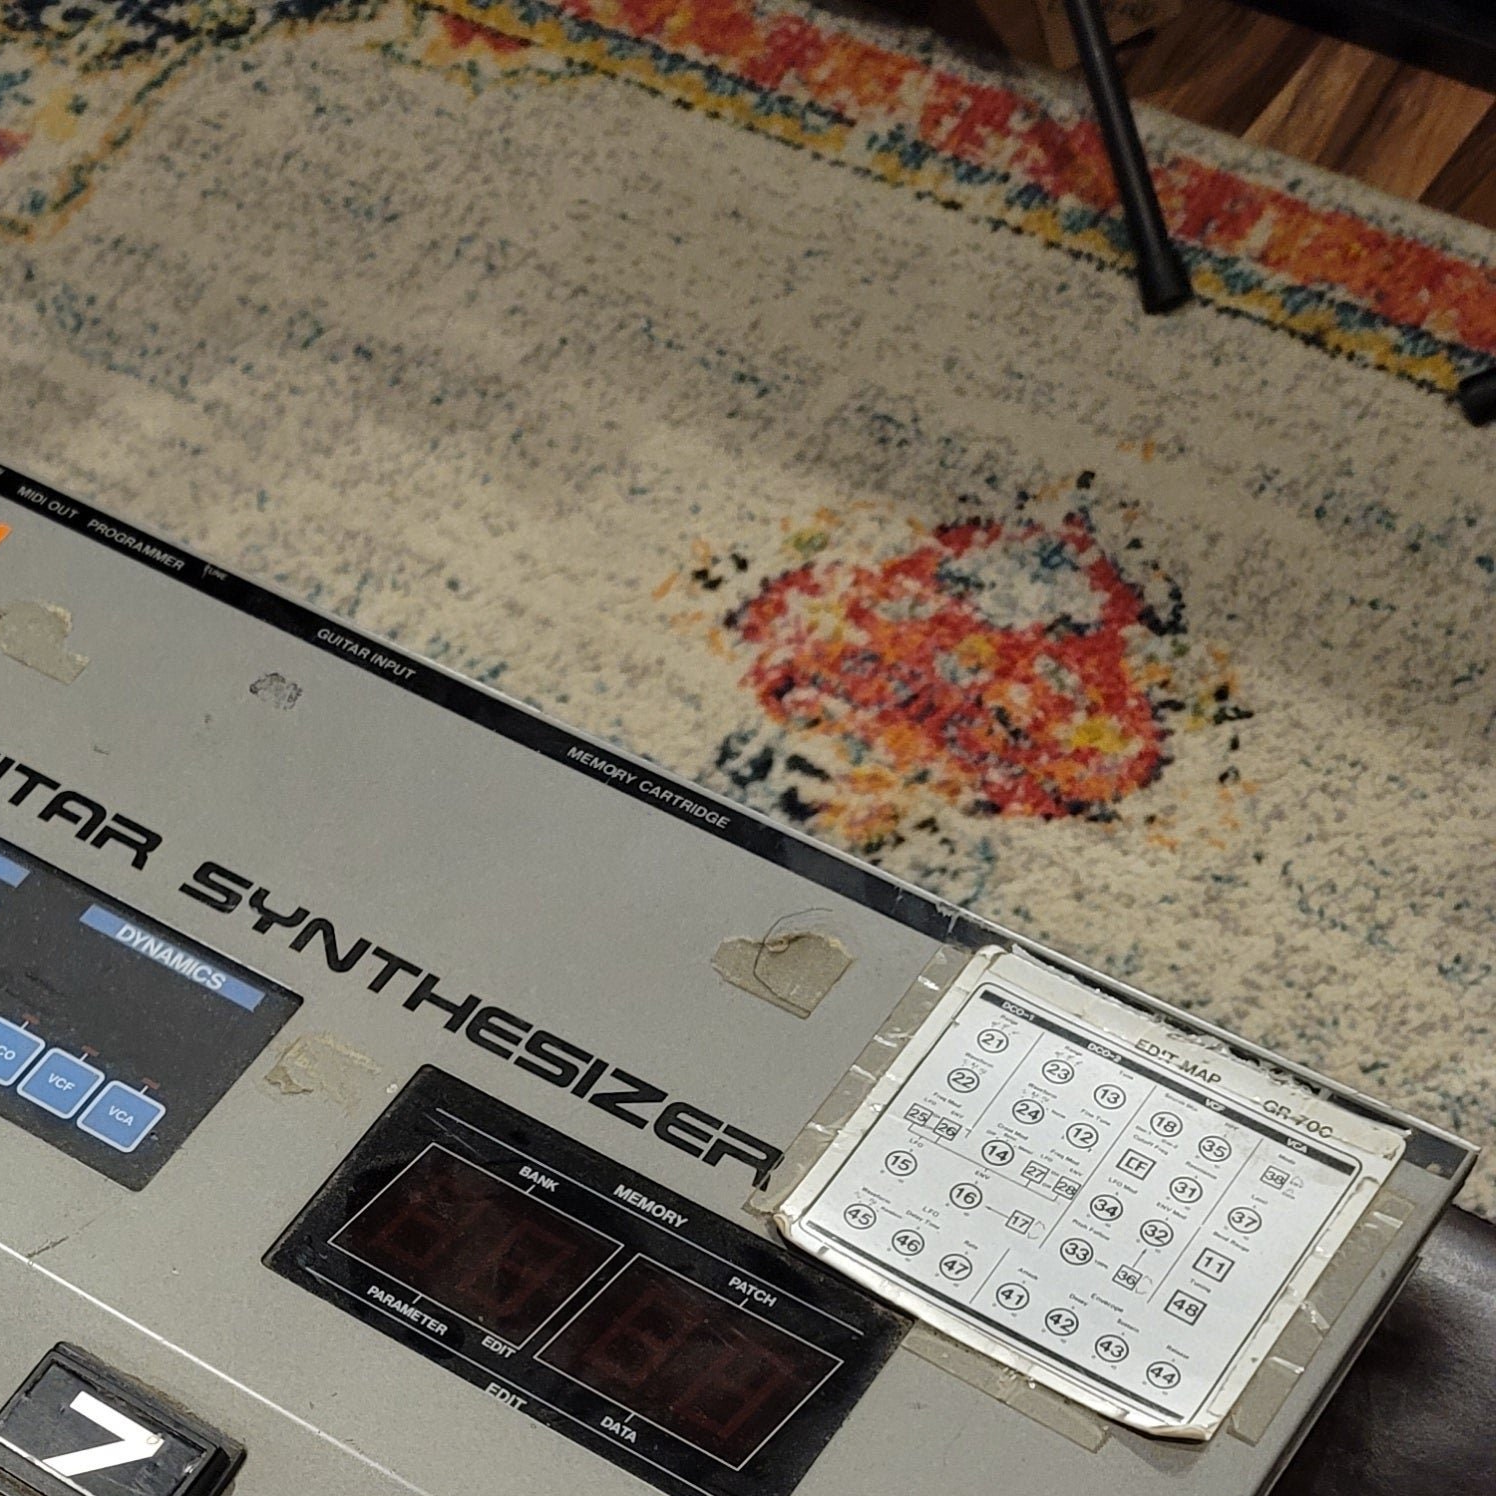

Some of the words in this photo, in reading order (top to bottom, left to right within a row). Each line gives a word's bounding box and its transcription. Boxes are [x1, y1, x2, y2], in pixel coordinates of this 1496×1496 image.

[17, 485, 48, 506] MIDI
[48, 500, 80, 520] OUT
[86, 518, 186, 572] PROGRAMMER
[317, 627, 371, 660] GUITAR
[371, 653, 416, 681] INPUT
[567, 746, 638, 785] MEMORY
[638, 780, 732, 830] CARTRIDGE
[114, 922, 227, 991] DYNAMICS
[1002, 1001, 1036, 1022] DCO-1
[178, 860, 788, 1192] SYNTHESIZER
[981, 1032, 1004, 1050] 21
[1087, 1041, 1122, 1063] DCO-2
[952, 1071, 976, 1089] 22
[1046, 1063, 1071, 1081] 23
[1179, 1060, 1222, 1085] MAP
[48, 1072, 76, 1093] VCF
[1099, 1088, 1121, 1105] 13
[108, 1104, 135, 1127] VCA
[908, 1109, 928, 1124] 25
[1016, 1102, 1041, 1121] 24
[937, 1122, 956, 1137] 26
[1157, 1116, 1178, 1133] 18
[909, 1138, 924, 1148] LFO
[1071, 1127, 1094, 1145] 12
[987, 1145, 1010, 1162] 14
[1202, 1140, 1228, 1158] 35
[1285, 1137, 1309, 1154] VCA
[890, 1155, 912, 1172] 15
[1025, 1165, 1044, 1180] 27
[1125, 1156, 1149, 1172] CF
[517, 1164, 561, 1193] BANK
[974, 1170, 991, 1181] ENV
[1263, 1170, 1286, 1185] 38
[1056, 1181, 1077, 1196] 28
[1108, 1177, 1123, 1188] LFO
[1122, 1184, 1138, 1195] Mod
[1174, 1181, 1198, 1199] 31
[955, 1187, 978, 1205] 16
[612, 1183, 689, 1230] MEMORY
[922, 1206, 940, 1218] LFO
[1094, 1199, 1119, 1217] 34
[1156, 1201, 1171, 1213] ENV
[1172, 1209, 1188, 1220] Mod
[847, 1208, 873, 1226] 45
[1011, 1215, 1030, 1230] 17
[1231, 1211, 1258, 1228] 37
[1144, 1224, 1169, 1244] 32
[896, 1234, 921, 1253] 46
[1064, 1243, 1090, 1261] 33
[943, 1260, 969, 1276] 47
[1204, 1256, 1226, 1274] 11
[1117, 1270, 1138, 1286] 36
[727, 1275, 777, 1309] PATCH
[1001, 1288, 1025, 1306] 41
[366, 1284, 449, 1337] PARAMETER
[1173, 1299, 1199, 1318] 48
[1049, 1313, 1075, 1332] 42
[480, 1334, 517, 1359] EDIT
[1099, 1340, 1125, 1358] 43
[1150, 1366, 1176, 1385] 44
[483, 1382, 528, 1411] EDIT
[42, 1390, 165, 1478] 7
[599, 1415, 639, 1444] DATA
